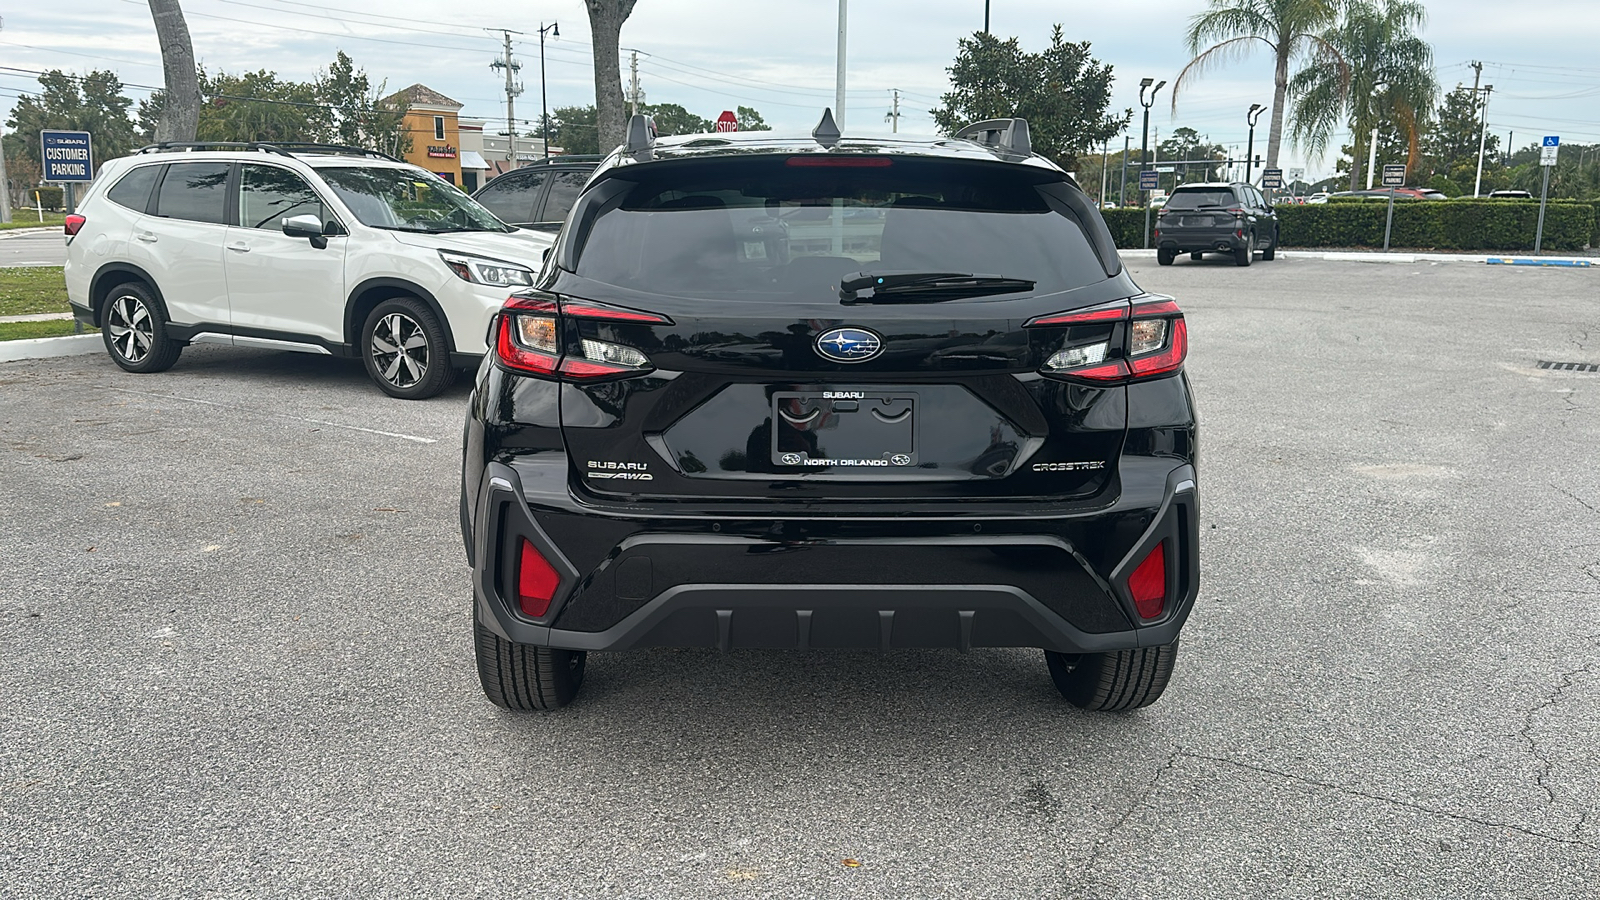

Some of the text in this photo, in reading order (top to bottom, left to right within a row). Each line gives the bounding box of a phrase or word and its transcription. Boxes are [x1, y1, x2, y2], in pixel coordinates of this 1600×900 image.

[718, 121, 737, 132] STOP
[46, 147, 88, 160] CUSTOMER
[51, 163, 86, 175] PARKING
[823, 391, 865, 399] SUBARU
[587, 460, 648, 471] SUBARU
[1032, 460, 1106, 472] CROSSTREK
